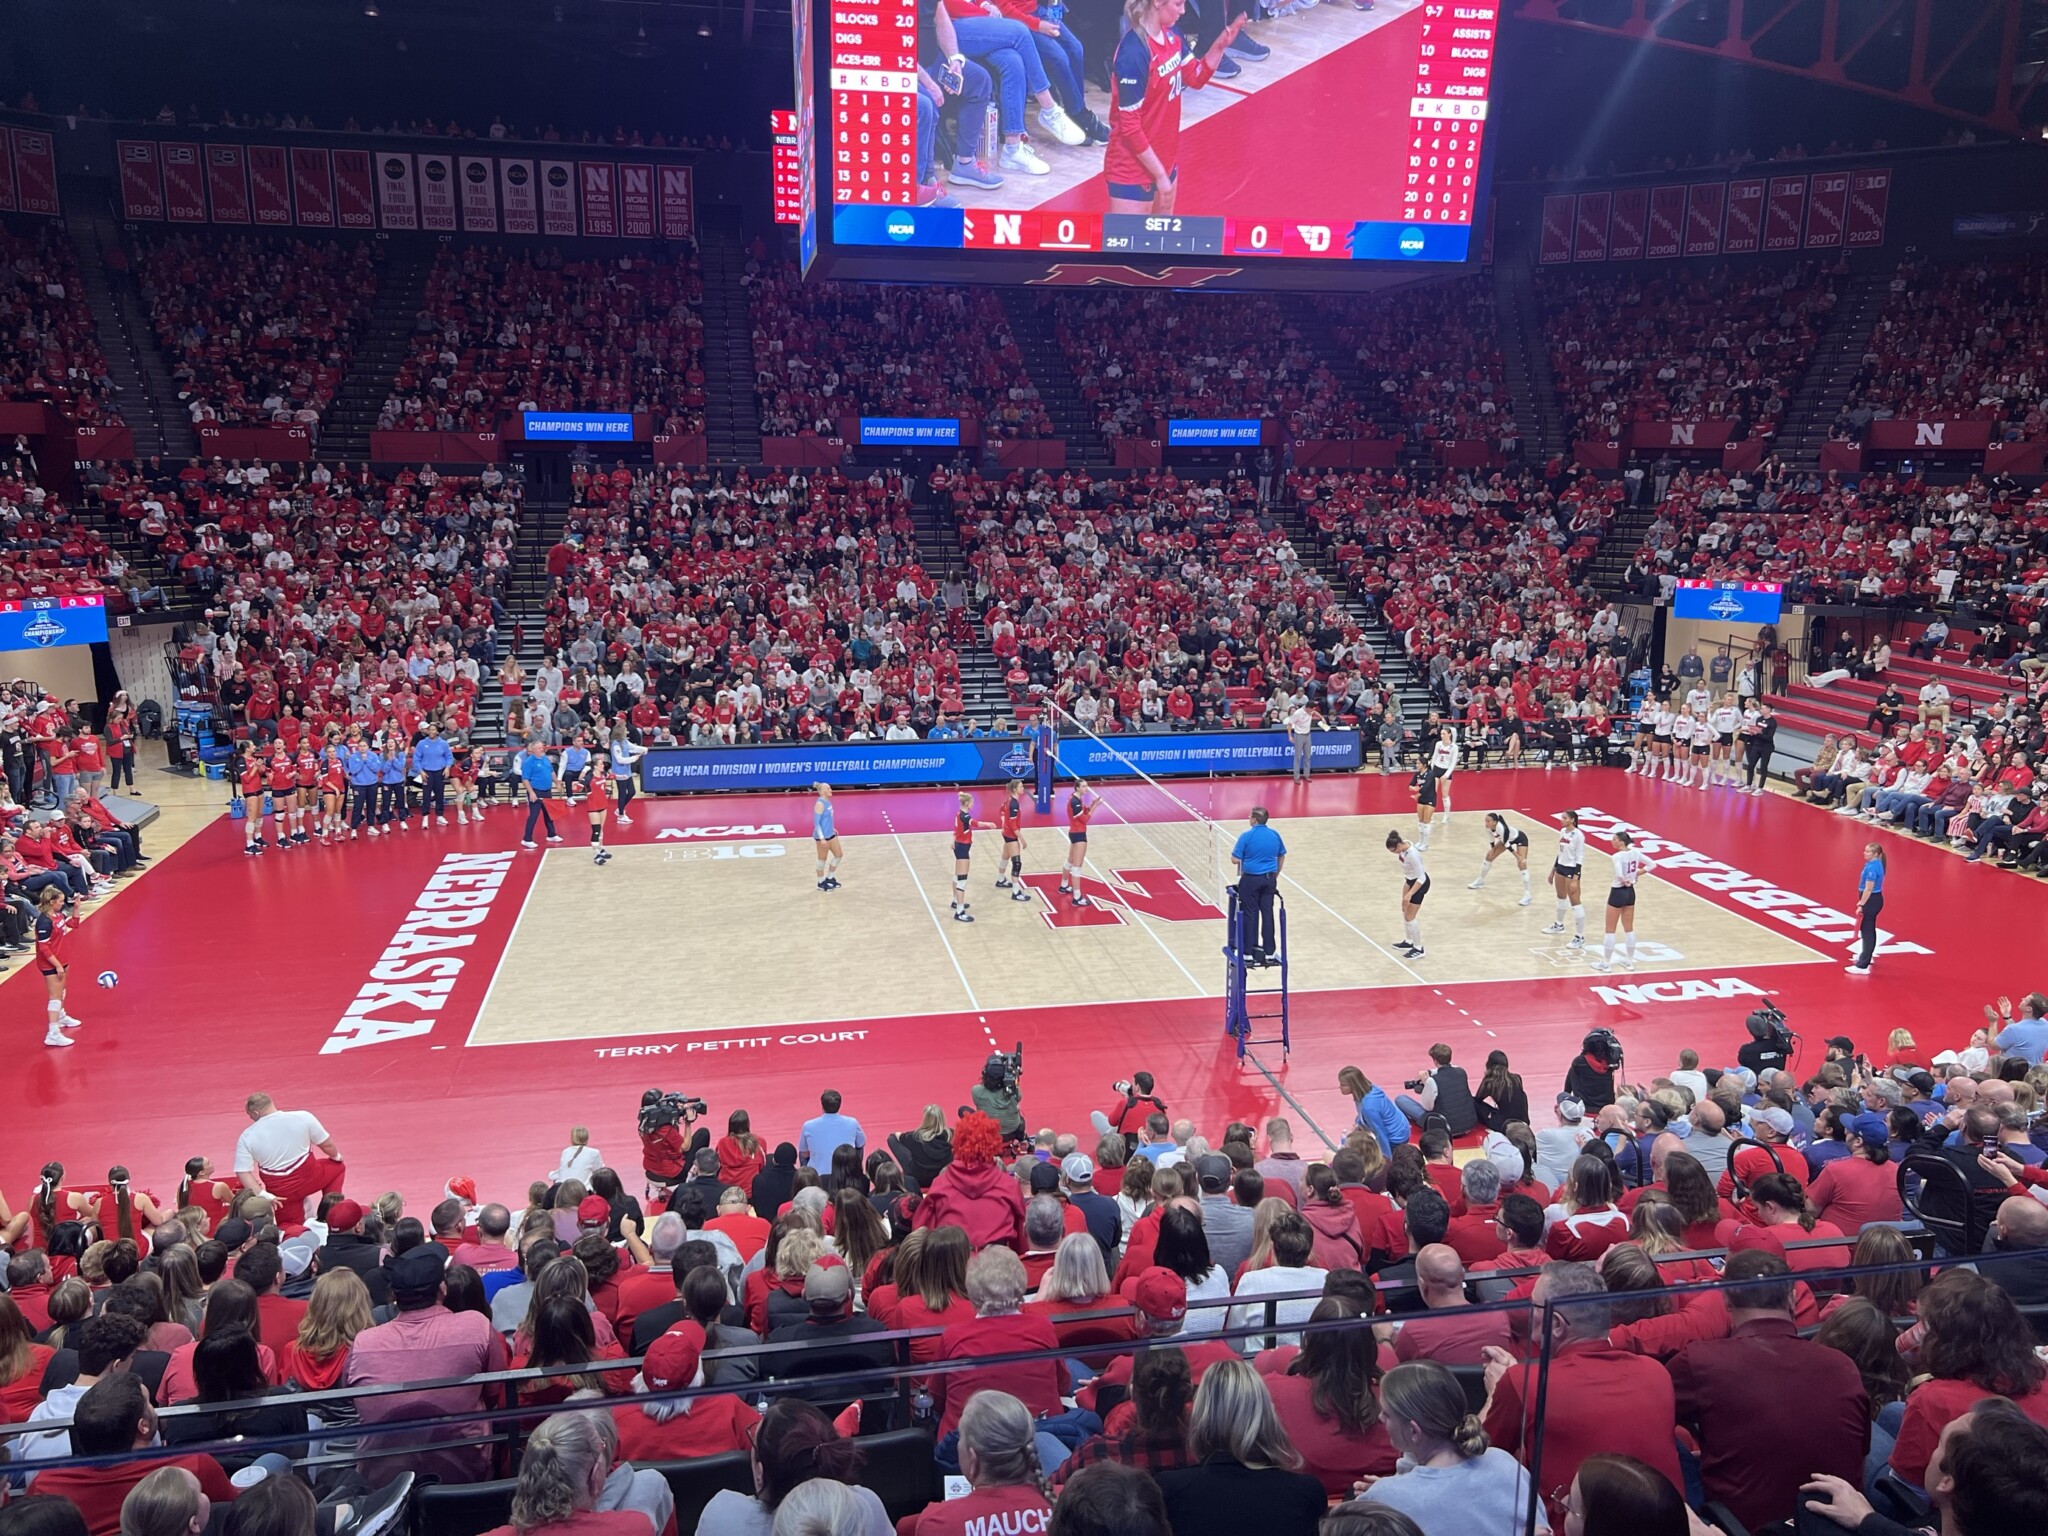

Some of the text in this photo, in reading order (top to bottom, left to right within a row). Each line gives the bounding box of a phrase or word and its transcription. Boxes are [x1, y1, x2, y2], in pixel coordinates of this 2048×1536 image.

[1426, 5, 1494, 19] 9-7 KILLS-ERR
[836, 13, 878, 25] BLOCKS
[1423, 25, 1491, 39] 7 ASSISTS
[836, 33, 914, 47] DIGS 19
[1451, 47, 1488, 59] BLOCKS
[836, 54, 914, 68] ACES-ERR 1-2
[1419, 64, 1486, 77] 12 DIGS
[861, 76, 911, 88] K B D
[1417, 83, 1484, 96] 1-3 ACES-ERR
[840, 93, 910, 108] 2 1 1 2
[1436, 104, 1480, 115] K B D
[840, 112, 910, 126] 5 4 0 0
[1418, 120, 1477, 133] 1 0 0 0
[776, 136, 797, 145] NEBR
[840, 132, 910, 145] 8 0 0 5
[1413, 138, 1475, 151] 4 4 0 2
[838, 151, 910, 165] 12 3 0 0
[586, 167, 609, 192] N
[624, 169, 648, 193] N
[663, 170, 687, 195] N
[838, 170, 910, 184] 13 0 1 2
[587, 194, 609, 202] NCAA
[625, 196, 648, 204] NCAA
[664, 197, 687, 205] NCAA
[838, 189, 910, 202] 27 4 0 2
[129, 204, 161, 216] 1992
[171, 207, 203, 218] 1994
[258, 209, 287, 221] 1996
[1812, 197, 1841, 231] CHAMPION
[1852, 194, 1882, 228] CHAMPION
[301, 211, 330, 223] 1998
[342, 213, 371, 224] 1999
[385, 216, 415, 226] 1986
[426, 217, 453, 228] 1989
[467, 218, 494, 229] 1990
[507, 220, 535, 230] 1996
[548, 222, 574, 232] 1998
[588, 220, 612, 233] 1995
[627, 222, 651, 234] 2000
[994, 214, 1074, 244] N 0
[1145, 218, 1181, 231] SET 2
[1251, 226, 1267, 248] 0
[1767, 237, 1795, 247] 2016
[1809, 234, 1838, 245] 2017
[1850, 230, 1880, 242] 2023
[1107, 238, 1128, 247] 25-17
[1688, 242, 1715, 252] 2010
[1728, 239, 1754, 249] 2011
[1577, 249, 1603, 259] 2006
[1612, 247, 1639, 257] 2007
[1650, 244, 1677, 255] 2008
[1543, 252, 1568, 261] 2005
[78, 427, 96, 436] C15
[202, 428, 220, 437] C16
[289, 429, 306, 438] C16
[528, 422, 629, 433] CHAMPIONS WIN HERE
[864, 427, 956, 437] CHAMPIONS WIN HERE
[1172, 428, 1258, 438] CHAMPIONS WIN HERE
[479, 433, 495, 441] C17
[1670, 424, 1695, 445] N
[1915, 423, 1945, 445] N
[828, 438, 843, 446] C18
[74, 461, 91, 470] B15
[32, 601, 50, 609] 1:30
[24, 628, 65, 637] CHAMPIONSHIP
[1089, 752, 1113, 762] 2024
[1141, 750, 1180, 760] DIVISION
[1182, 749, 1186, 759] I
[1187, 748, 1231, 759] WOMEN'S
[1232, 746, 1283, 758] VOLLEYBALL
[1285, 744, 1352, 756] CHPIONSHIP
[652, 758, 945, 777] 2024 NCAA DIVISION I WOMEN'S VOLLEYBALL CHAMPIONSHIP
[655, 824, 788, 839] NCAA
[1626, 861, 1637, 874] 13
[318, 851, 517, 1055] NEBRASKA
[1589, 977, 1768, 1006] NCAA
[594, 1030, 869, 1059] TERRY PETTIT COURT
